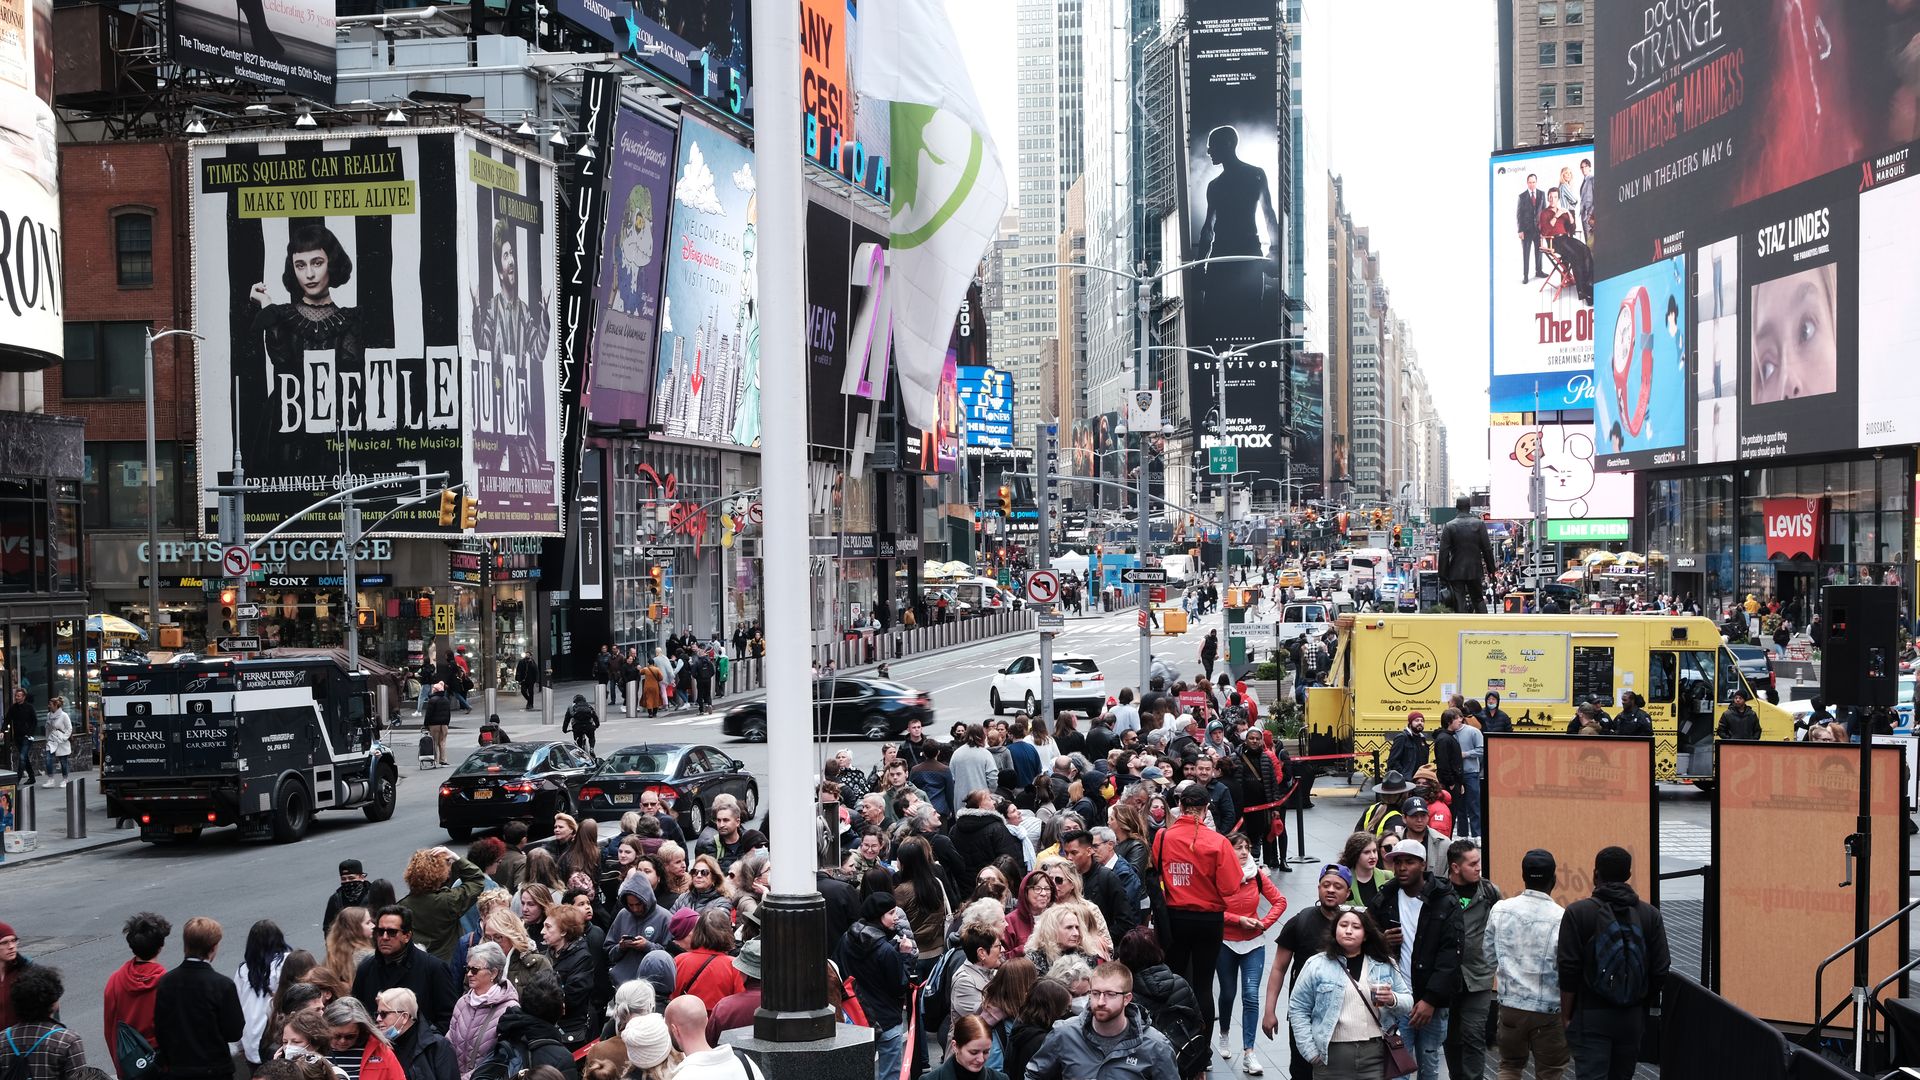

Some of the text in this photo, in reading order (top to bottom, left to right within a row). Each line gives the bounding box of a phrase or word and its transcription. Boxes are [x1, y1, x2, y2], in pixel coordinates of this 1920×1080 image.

[307, 9, 315, 21] 35
[179, 34, 192, 48] The
[193, 38, 220, 55] Theater
[221, 46, 243, 61] Center
[243, 51, 259, 65] 1627
[260, 56, 290, 75] Broadway
[290, 66, 298, 76] at
[313, 70, 333, 85] Street
[234, 66, 286, 87] ticketmaster.com
[1609, 82, 1677, 169] MULTIVERSE
[1683, 47, 1745, 132] MADNESS
[1876, 148, 1909, 169] MARRIOTT
[207, 152, 397, 185] TIMES SQUARE CAN REALLY
[1619, 137, 1732, 203] ONLY IN THEATERS MAY 6
[1876, 163, 1905, 182] MARQUIS
[244, 186, 411, 212] MAKE YOU FEEL ALIVE!
[684, 217, 720, 245] WELCOME
[1757, 207, 1830, 257] STAZ LINDES
[684, 270, 704, 289] VISIT
[1535, 312, 1573, 344] The
[1548, 354, 1582, 366] STREAMING
[325, 438, 345, 452] The
[396, 437, 417, 450] The
[245, 474, 326, 493] CREAMINGLY
[301, 512, 326, 521] WINTER
[1560, 525, 1587, 536] LINE
[1414, 542, 1424, 551] 25
[179, 577, 203, 587] Niko
[269, 576, 308, 586] SONY
[318, 577, 346, 585] BOWE
[512, 570, 528, 578] SONY
[437, 606, 446, 631] ATM
[223, 640, 236, 648] ONE
[243, 670, 294, 682] FERRARI EXPRESS
[117, 728, 228, 743] FERRARI EXPRESS
[186, 740, 227, 749] CAR SERVICE
[1168, 862, 1194, 875] JERSEY
[1172, 875, 1191, 886] BOYS
